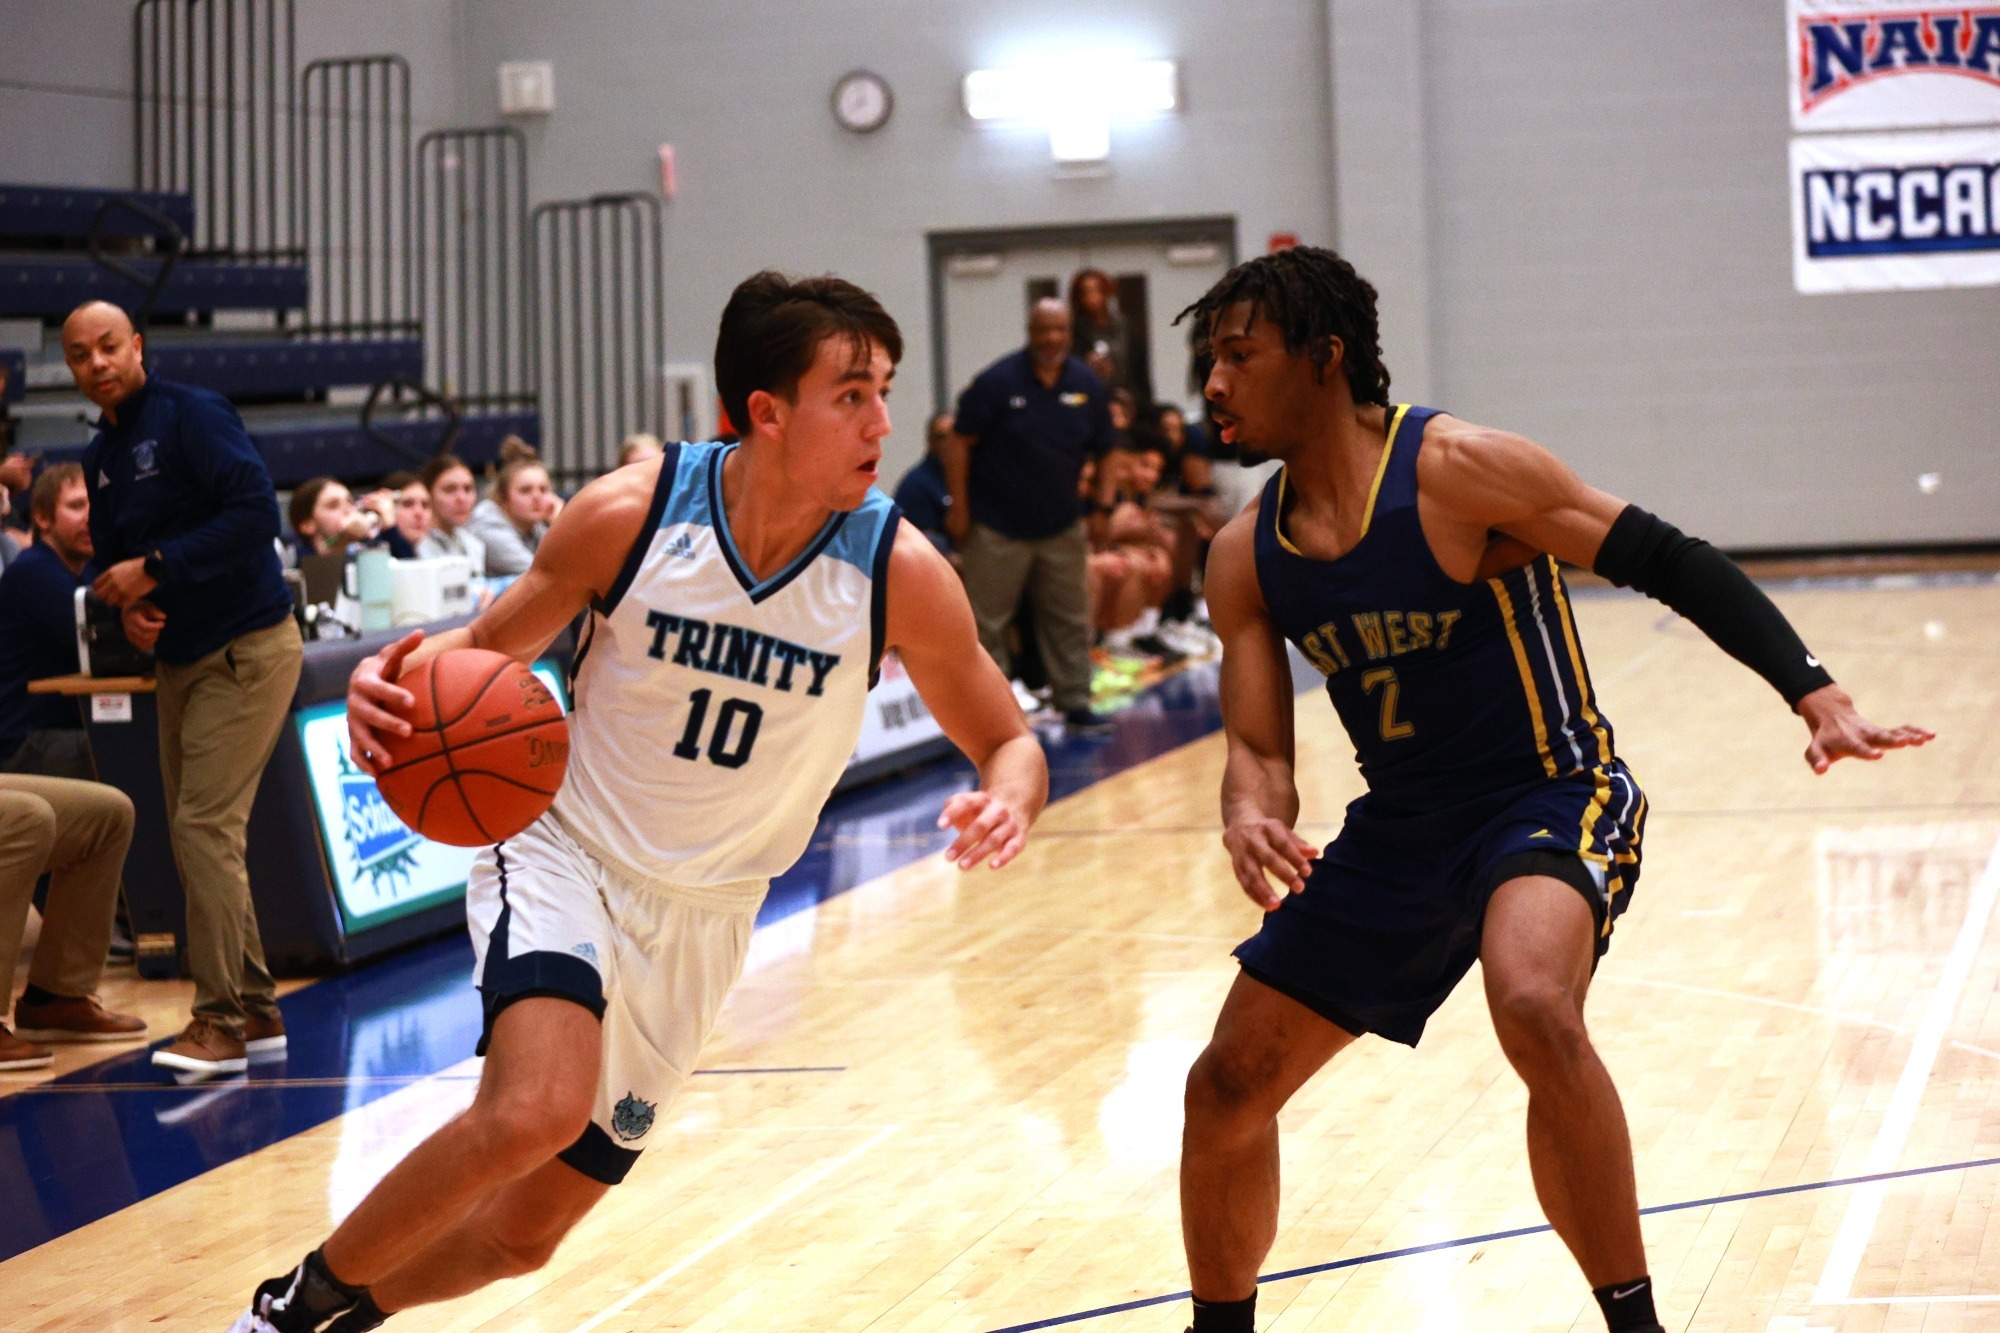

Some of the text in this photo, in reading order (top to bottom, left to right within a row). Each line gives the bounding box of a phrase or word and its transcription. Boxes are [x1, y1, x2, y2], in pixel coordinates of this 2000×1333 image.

[1807, 17, 2000, 92] NAIA
[1806, 164, 2000, 243] NCCA
[645, 608, 841, 697] TRINITY
[1302, 609, 1462, 676] ST WEST
[672, 688, 764, 769] 10
[1361, 666, 1415, 742] 2
